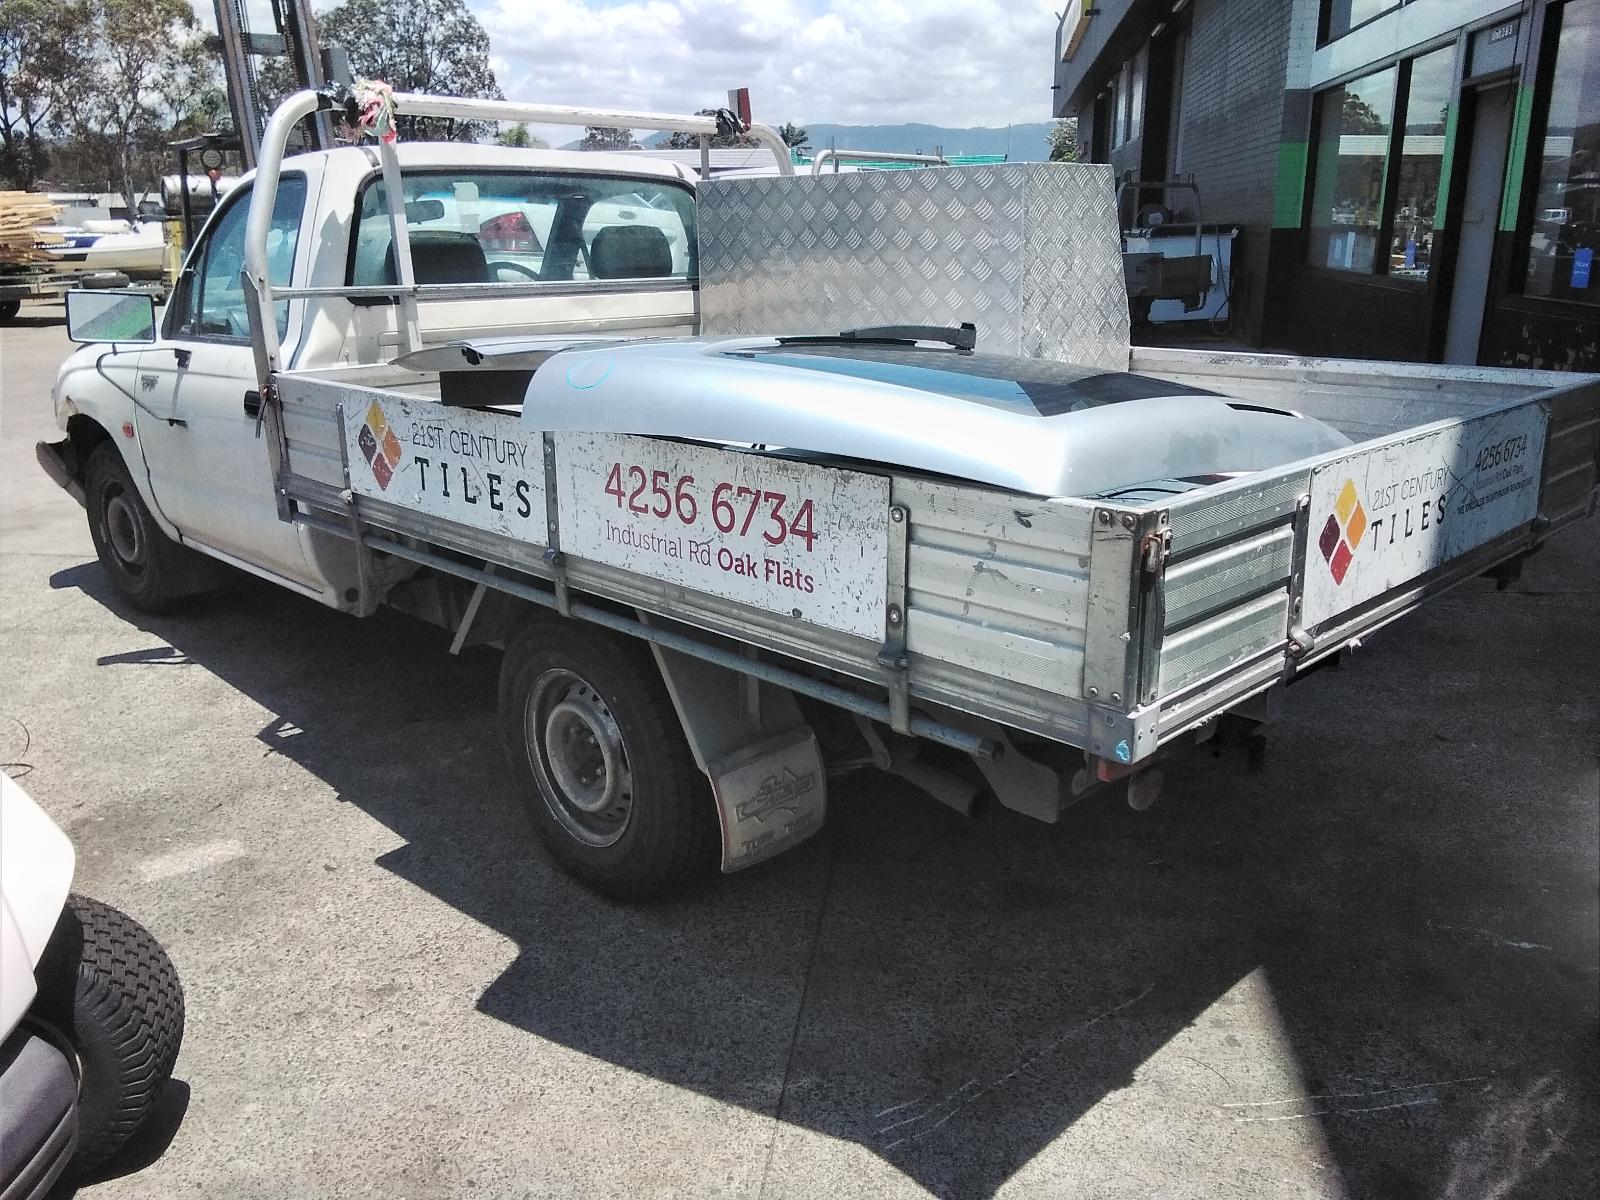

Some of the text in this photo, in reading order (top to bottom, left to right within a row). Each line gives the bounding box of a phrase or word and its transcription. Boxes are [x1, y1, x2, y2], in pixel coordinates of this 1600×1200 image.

[411, 422, 528, 468] 21ST CENTURY
[1475, 434, 1528, 472] 4256 6734
[414, 456, 532, 518] TILES
[604, 462, 819, 552] 4256 6734
[1371, 464, 1451, 512] 21ST CENTURY
[1370, 494, 1447, 552] TILES
[605, 519, 815, 594] Industrial Rd Oak Flats
